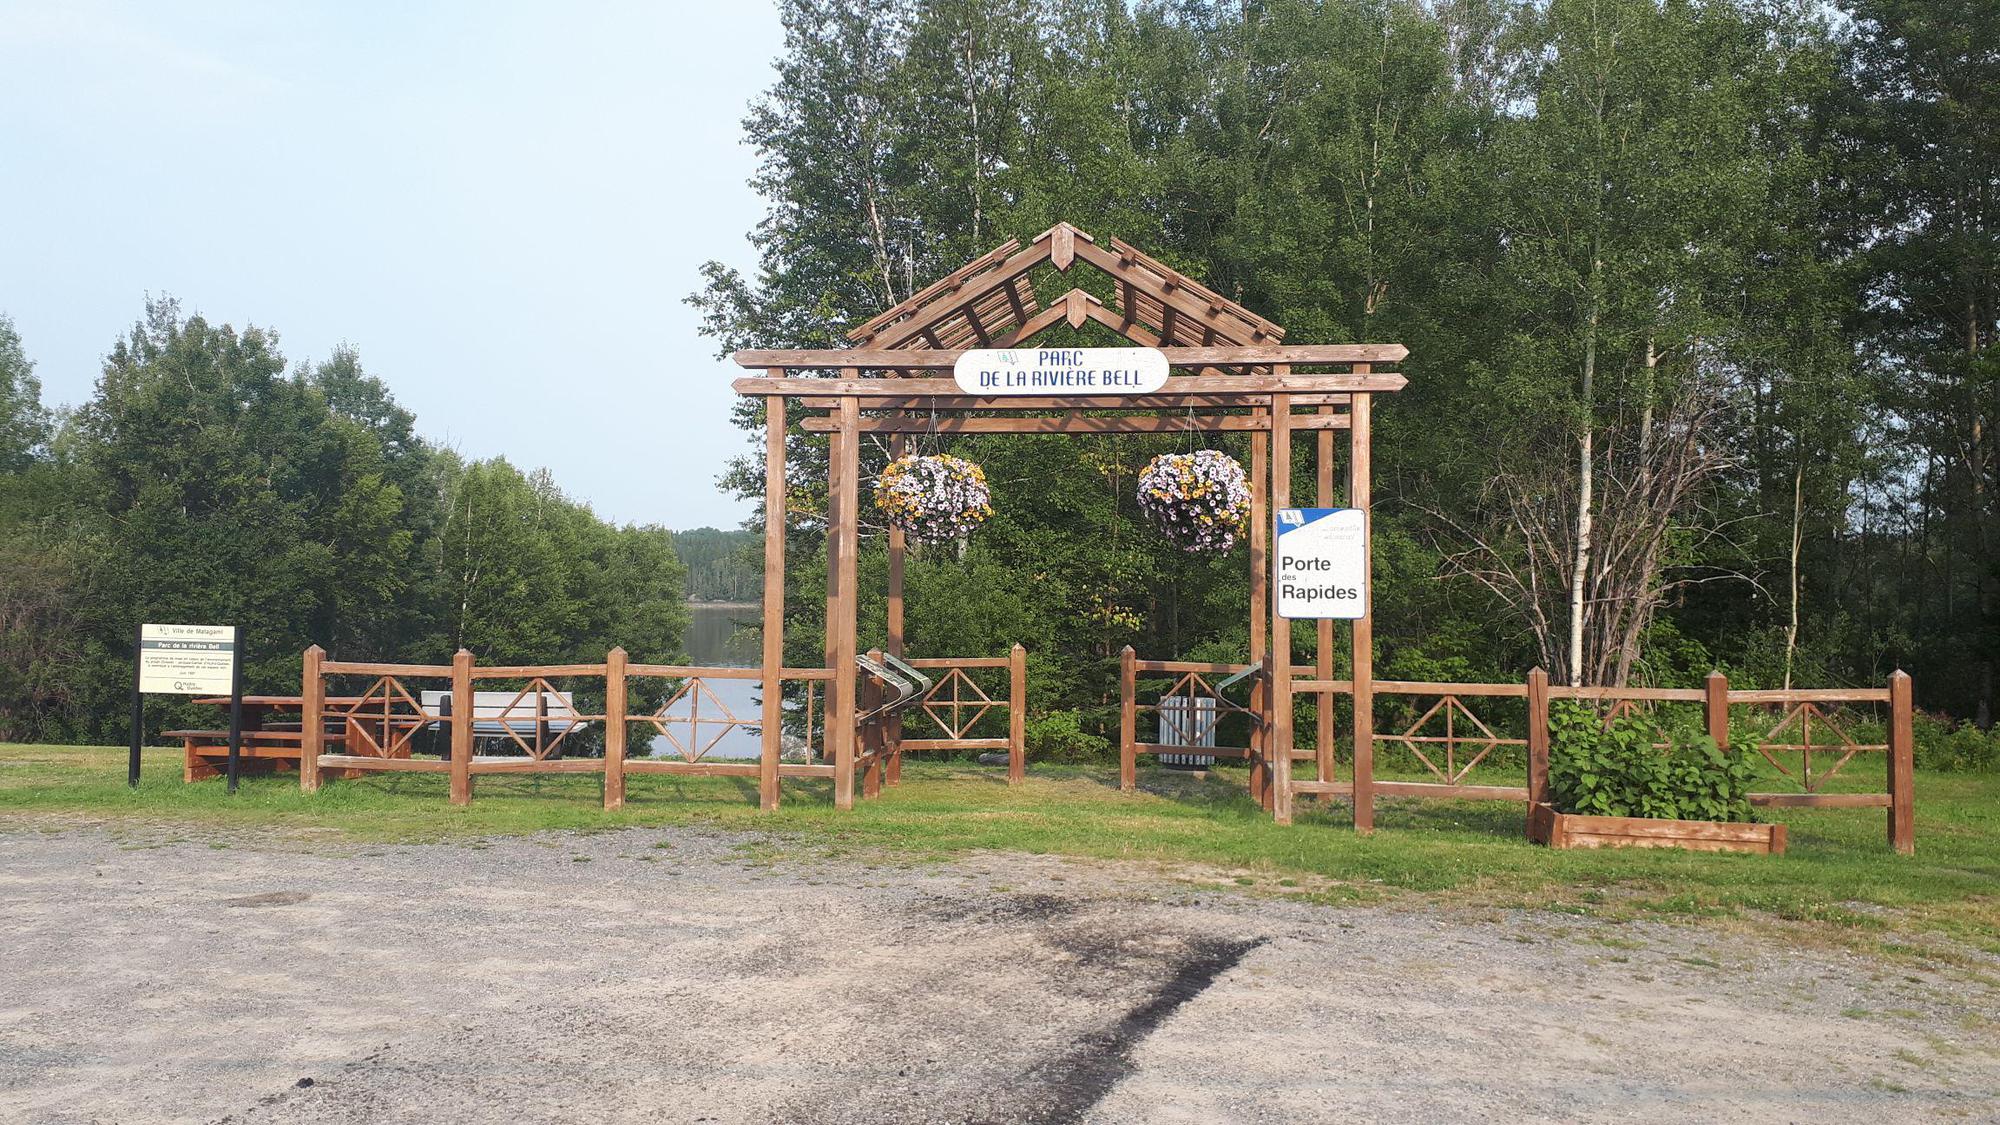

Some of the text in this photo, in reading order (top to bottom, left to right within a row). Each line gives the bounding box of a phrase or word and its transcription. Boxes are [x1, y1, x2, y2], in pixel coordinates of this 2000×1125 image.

[1039, 351, 1083, 366] PARC
[980, 367, 1143, 387] DE LA RIVIÈRE BELL
[1282, 556, 1331, 571] Porte
[1282, 584, 1358, 603] Rapides
